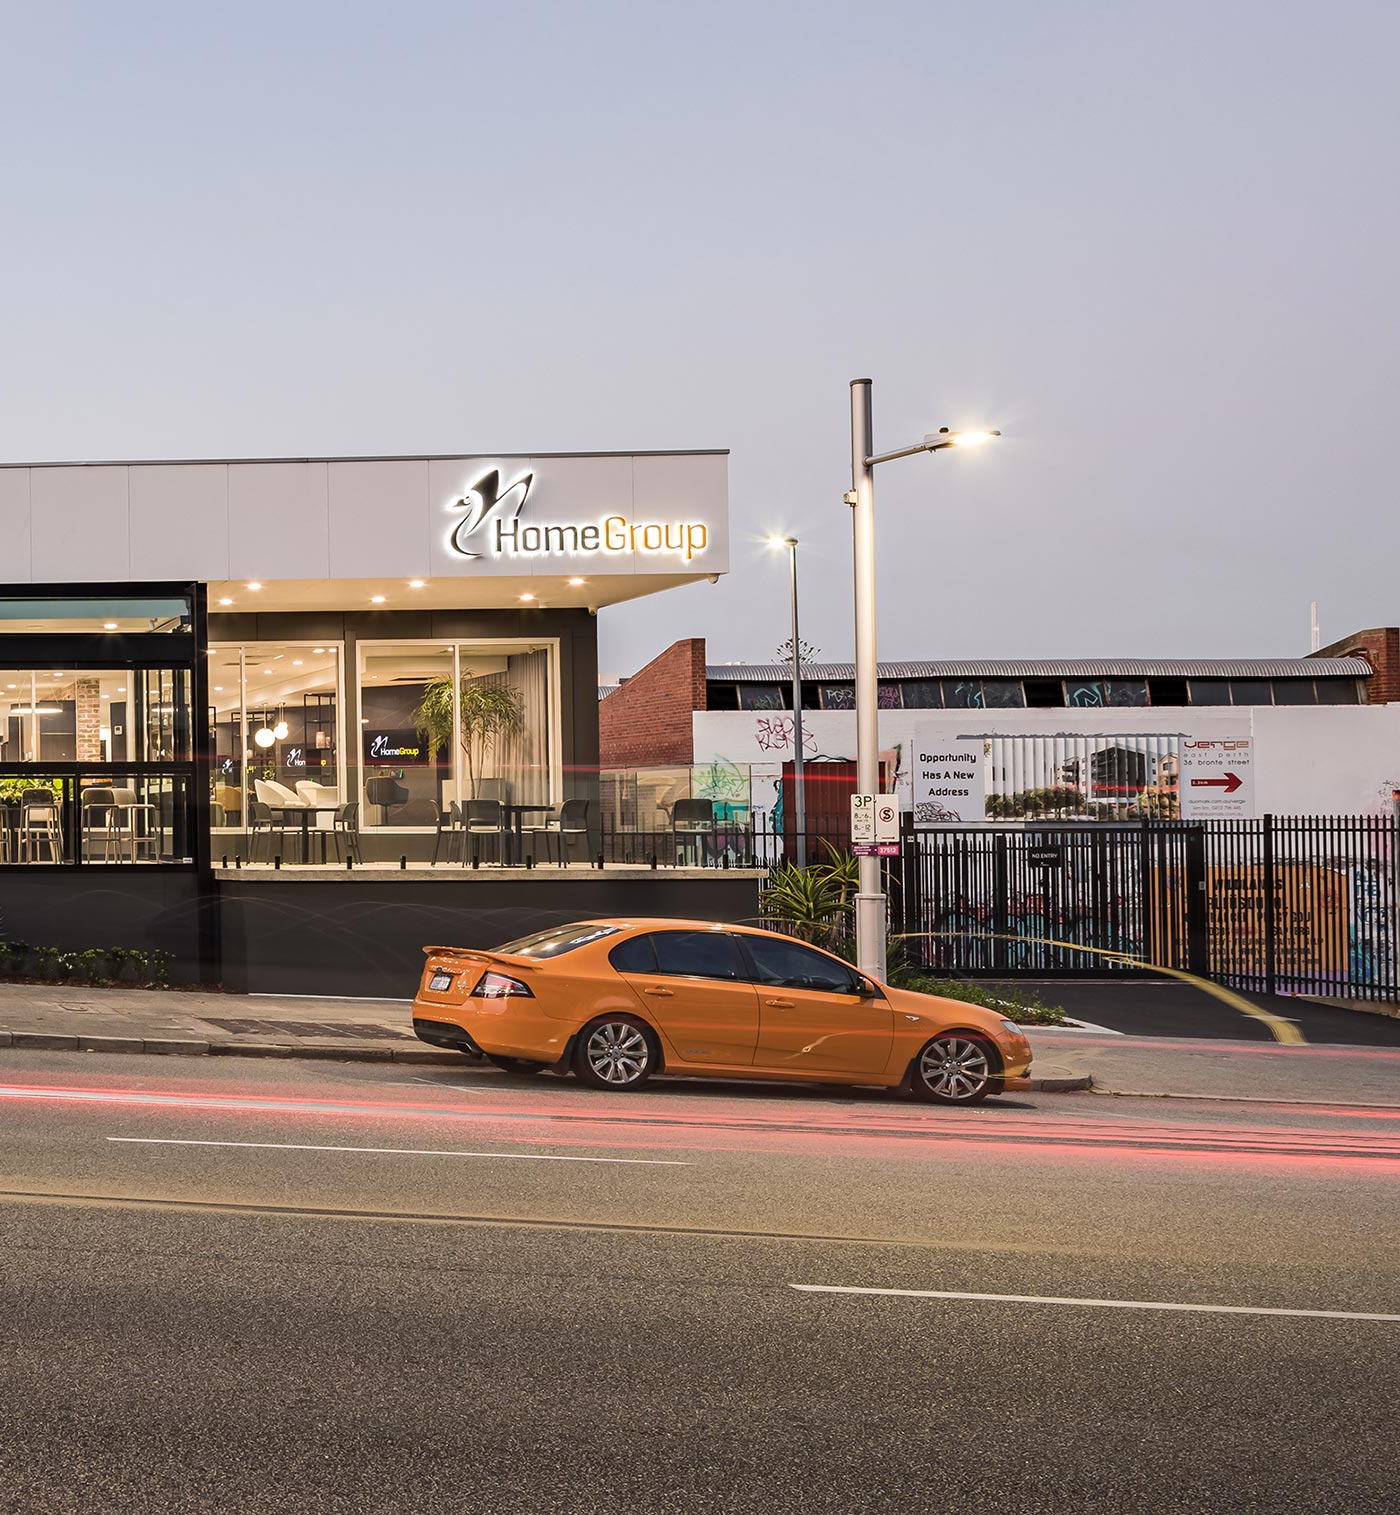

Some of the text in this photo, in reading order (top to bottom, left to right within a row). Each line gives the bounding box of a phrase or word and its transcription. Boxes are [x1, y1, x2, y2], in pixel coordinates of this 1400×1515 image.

[495, 515, 707, 560] HomeGroup
[1184, 741, 1249, 750] verge
[379, 747, 420, 758] HomeGroup
[919, 753, 977, 764] Opportunity
[922, 771, 975, 780] Has A New
[928, 788, 969, 796] Address
[854, 796, 872, 807] 3P
